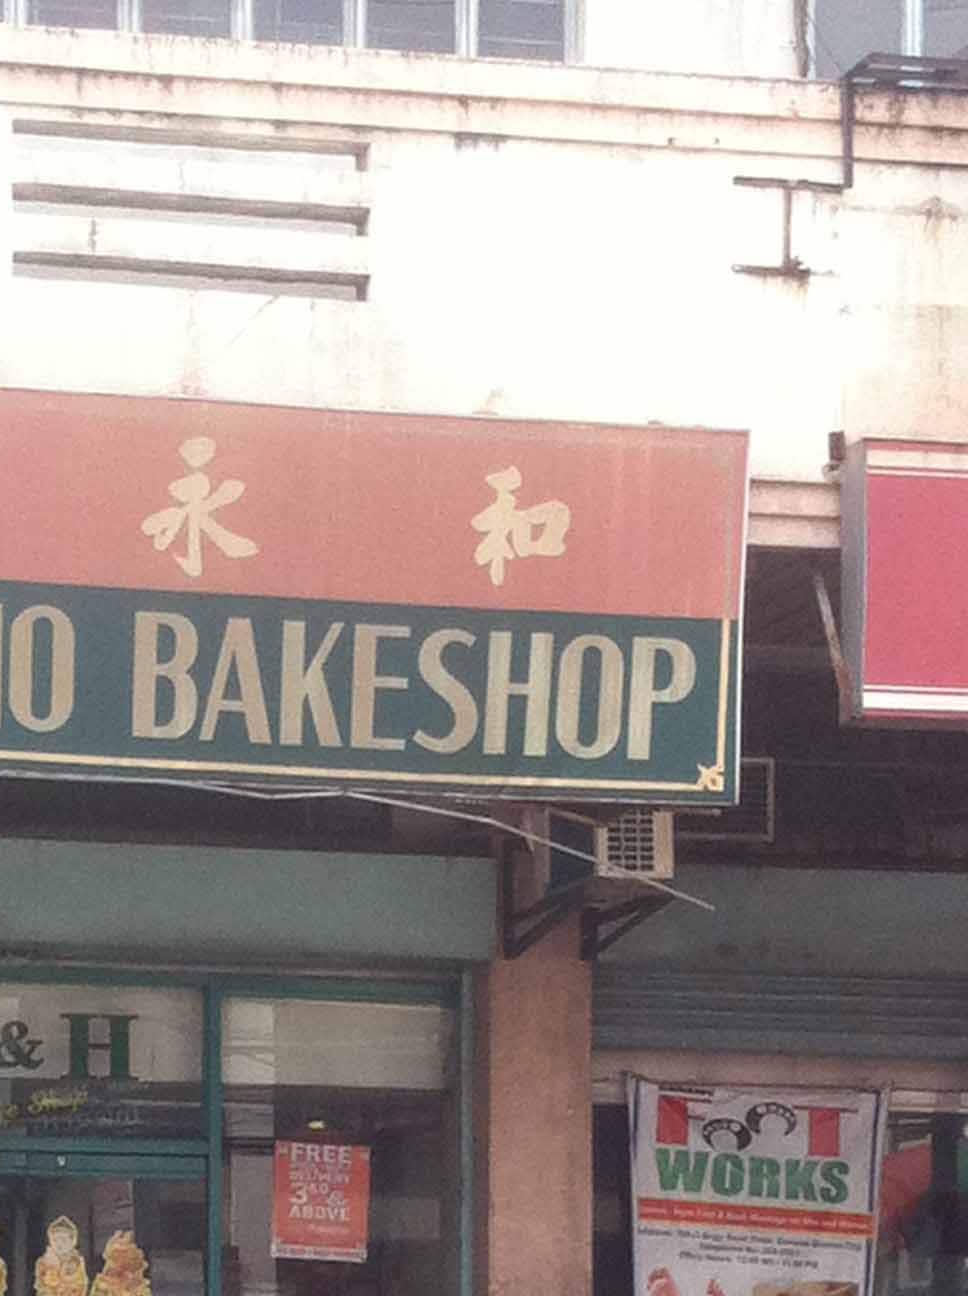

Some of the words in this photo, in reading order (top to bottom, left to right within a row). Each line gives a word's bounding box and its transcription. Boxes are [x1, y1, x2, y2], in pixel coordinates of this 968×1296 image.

[130, 609, 697, 761] BAKESHOP
[60, 1012, 139, 1081] H
[290, 1142, 352, 1163] FREE
[655, 1148, 849, 1204] WORKS
[289, 1205, 351, 1221] ABOVE
